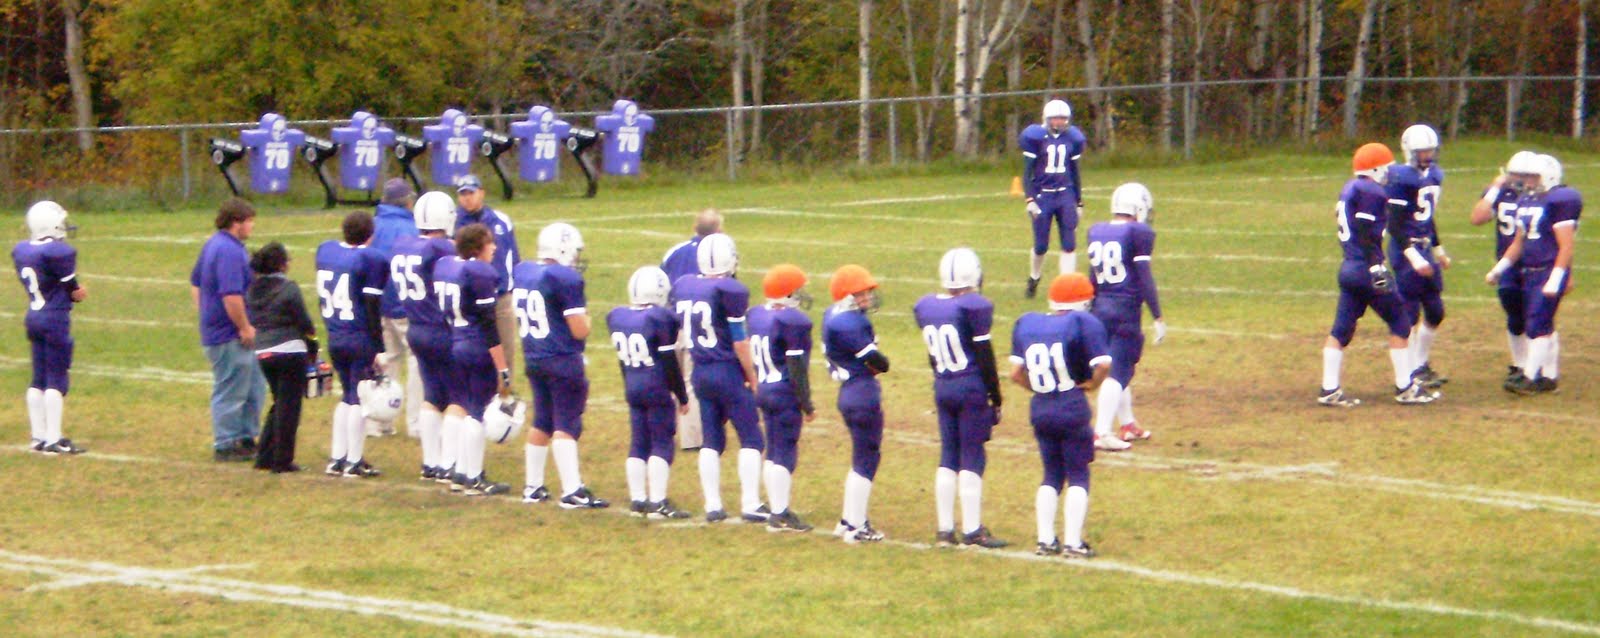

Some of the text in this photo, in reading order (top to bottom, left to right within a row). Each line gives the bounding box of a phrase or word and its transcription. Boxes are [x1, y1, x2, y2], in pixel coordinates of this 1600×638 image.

[1045, 144, 1067, 173] 11
[317, 270, 354, 320] 54
[512, 288, 550, 338] 59
[676, 300, 718, 348] 73
[1025, 342, 1076, 393] 81
